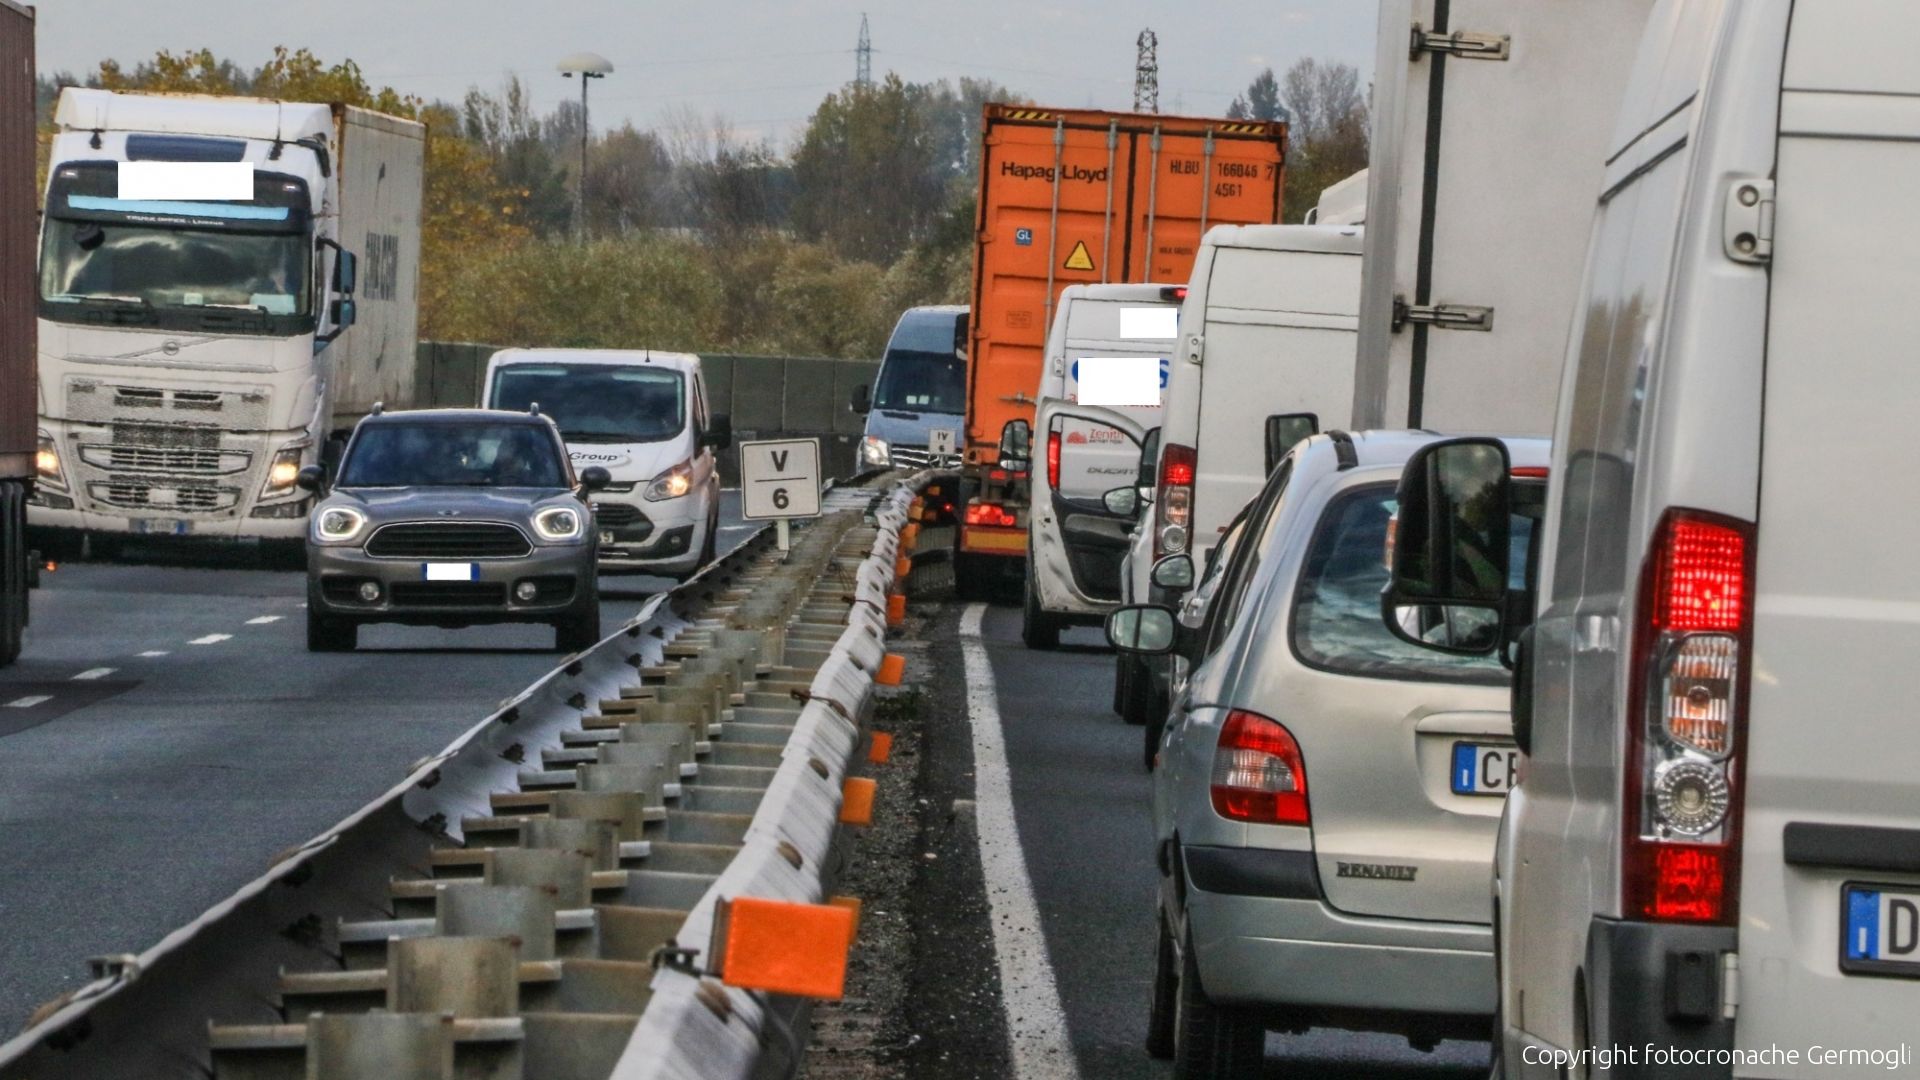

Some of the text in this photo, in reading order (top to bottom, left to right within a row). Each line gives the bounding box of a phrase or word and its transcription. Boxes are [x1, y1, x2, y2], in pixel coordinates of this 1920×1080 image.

[1170, 160, 1274, 180] HLBU 166046 7
[1016, 229, 1031, 240] GL
[937, 432, 948, 440] IV
[569, 452, 618, 462] Group
[771, 450, 788, 472] V
[773, 488, 789, 509] 6
[1336, 861, 1418, 881] RENAULT
